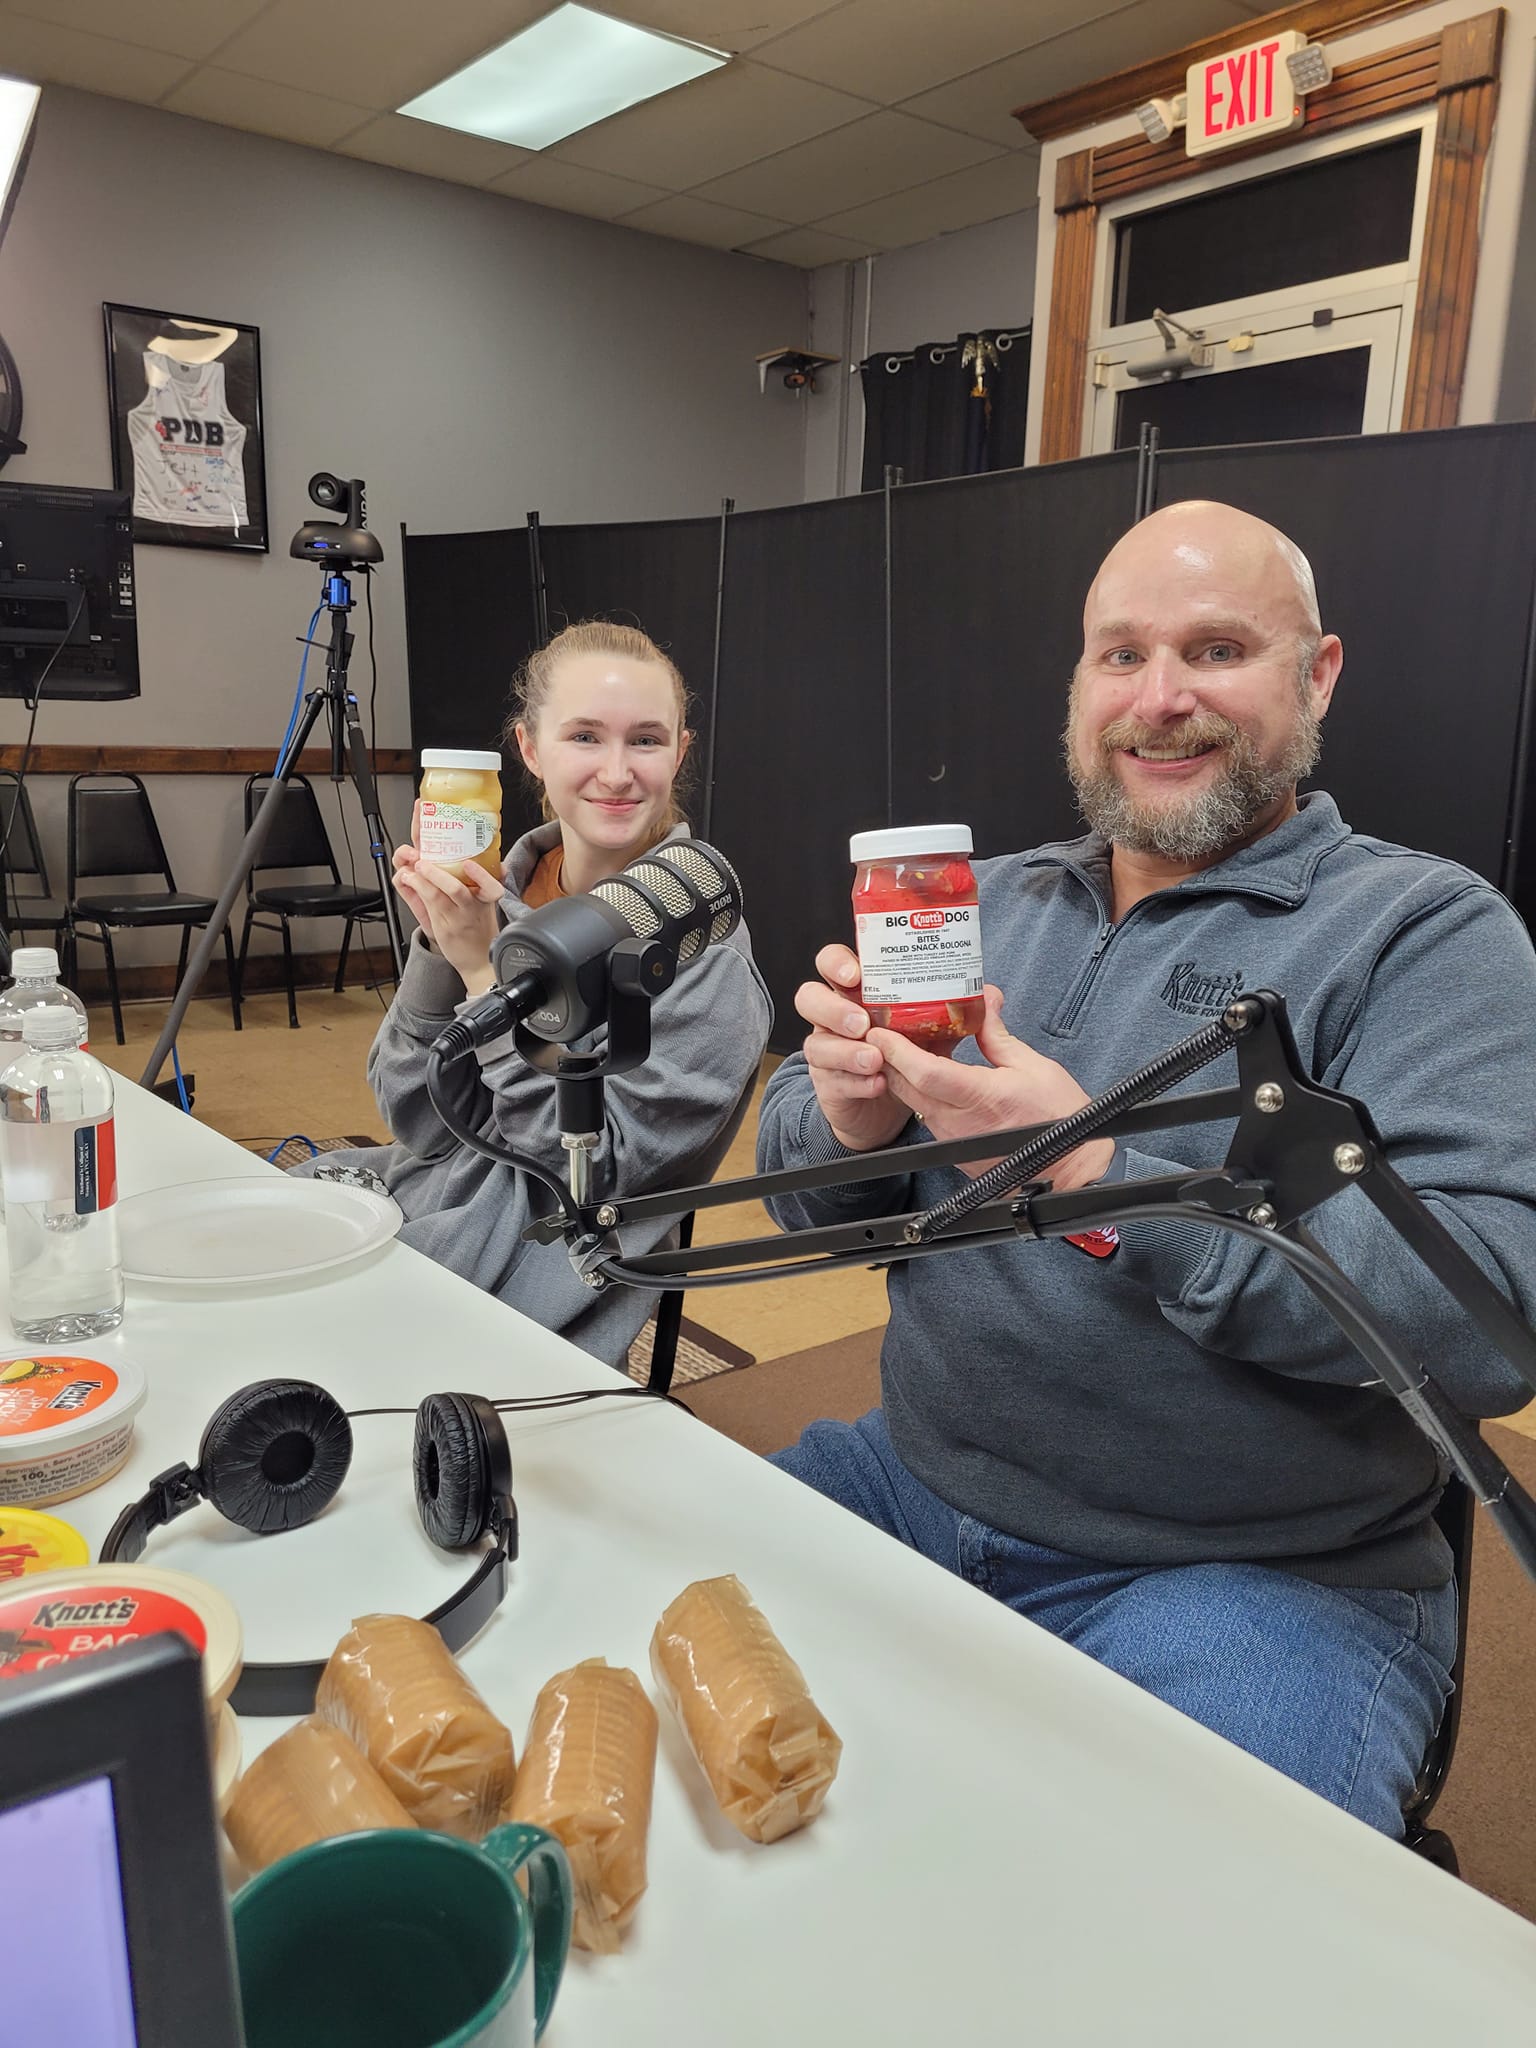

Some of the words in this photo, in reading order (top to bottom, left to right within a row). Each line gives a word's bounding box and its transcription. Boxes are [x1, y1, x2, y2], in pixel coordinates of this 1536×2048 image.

[1205, 42, 1280, 137] EXIT
[161, 416, 225, 447] PDB
[434, 821, 464, 830] PEEPS
[886, 916, 908, 927] BIG
[945, 911, 970, 923] DOG
[917, 935, 940, 943] BITES
[911, 943, 939, 952] SNACK
[940, 940, 972, 949] BOLOGNA
[926, 972, 967, 982] REFRIGERATED
[21, 1471, 48, 1481] 100,
[33, 1598, 137, 1629] Knott's
